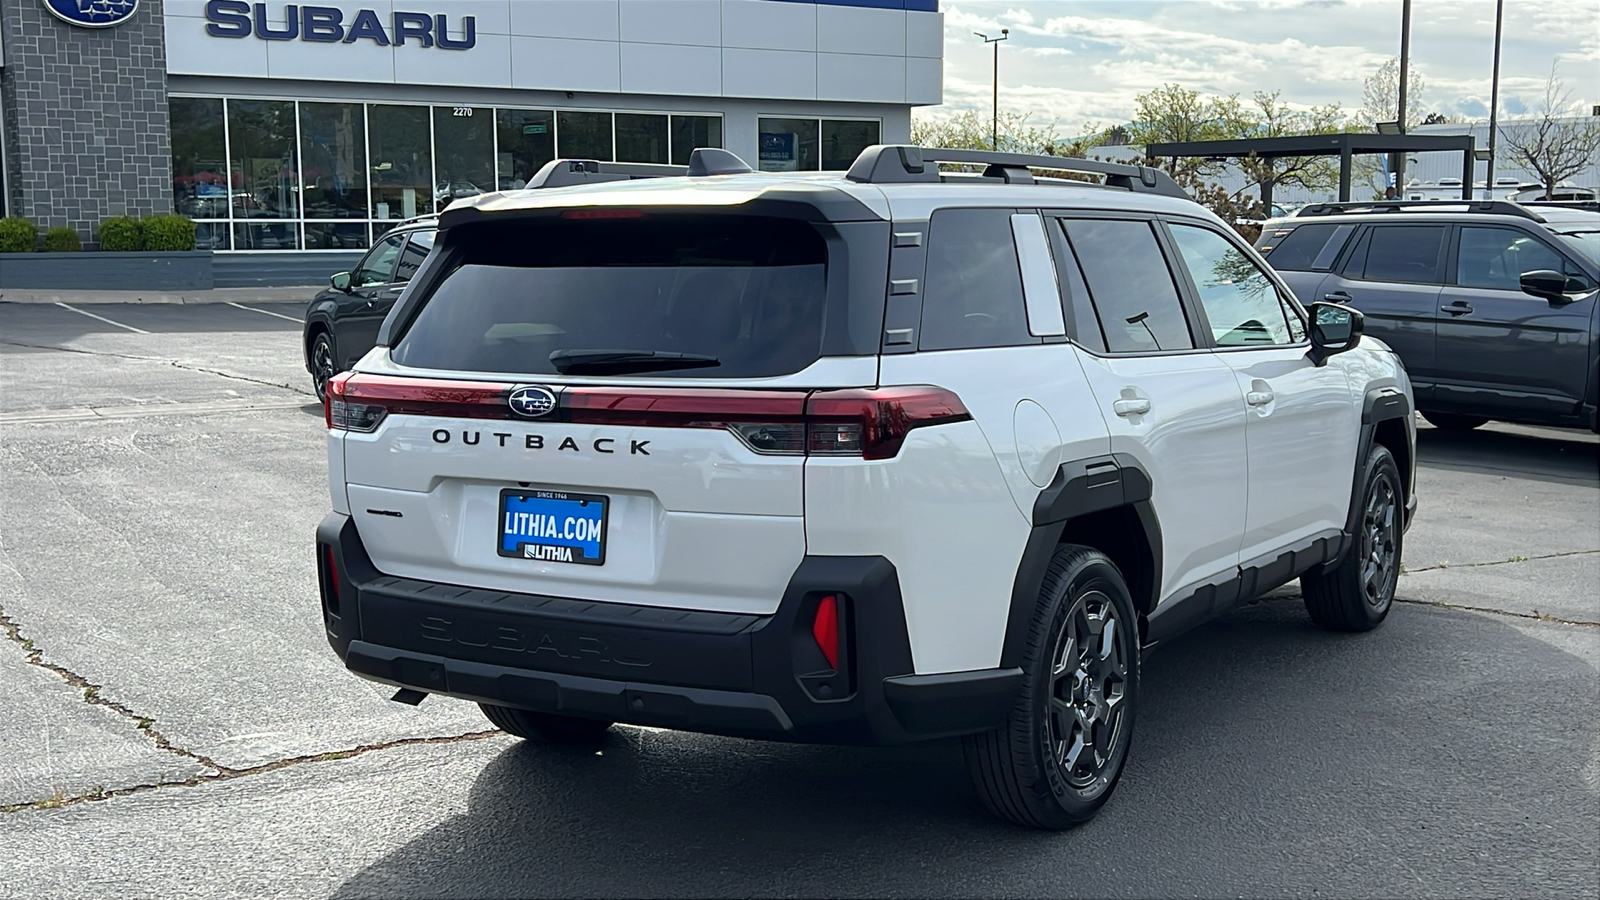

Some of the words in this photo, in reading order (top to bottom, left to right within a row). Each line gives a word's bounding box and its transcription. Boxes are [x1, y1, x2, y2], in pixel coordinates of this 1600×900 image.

[205, 0, 476, 50] SUBARU
[453, 107, 473, 117] 2270
[432, 429, 651, 456] OUTBACK
[536, 491, 554, 500] SINCE
[504, 511, 602, 543] LITHIA.COM
[535, 544, 573, 562] LITHIA
[420, 616, 653, 667] SUBARU
